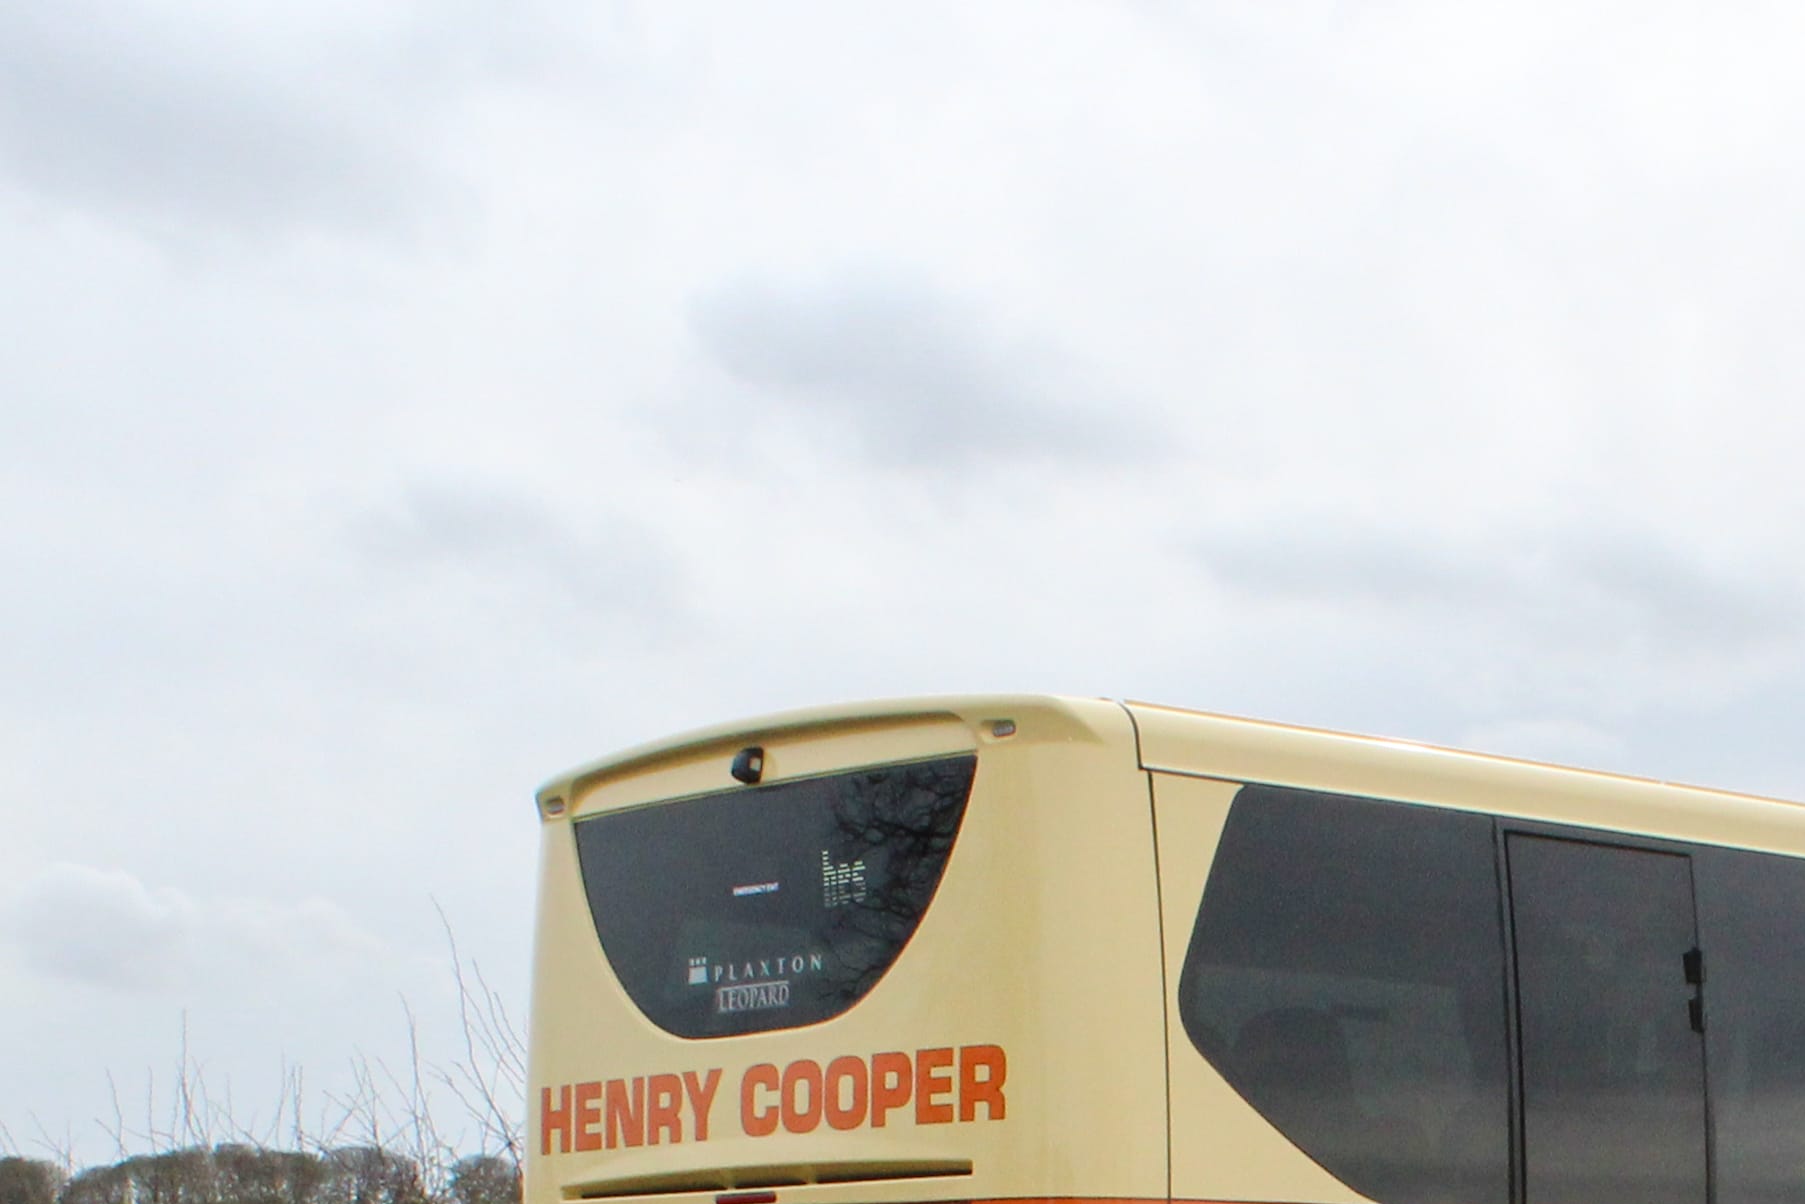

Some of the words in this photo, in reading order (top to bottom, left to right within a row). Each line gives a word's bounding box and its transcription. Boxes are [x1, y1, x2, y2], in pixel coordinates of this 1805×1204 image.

[714, 954, 823, 982] PLAXTON
[717, 983, 790, 1012] LEOPARD
[540, 1067, 723, 1156] HENRY
[740, 1043, 1008, 1138] COOPER
